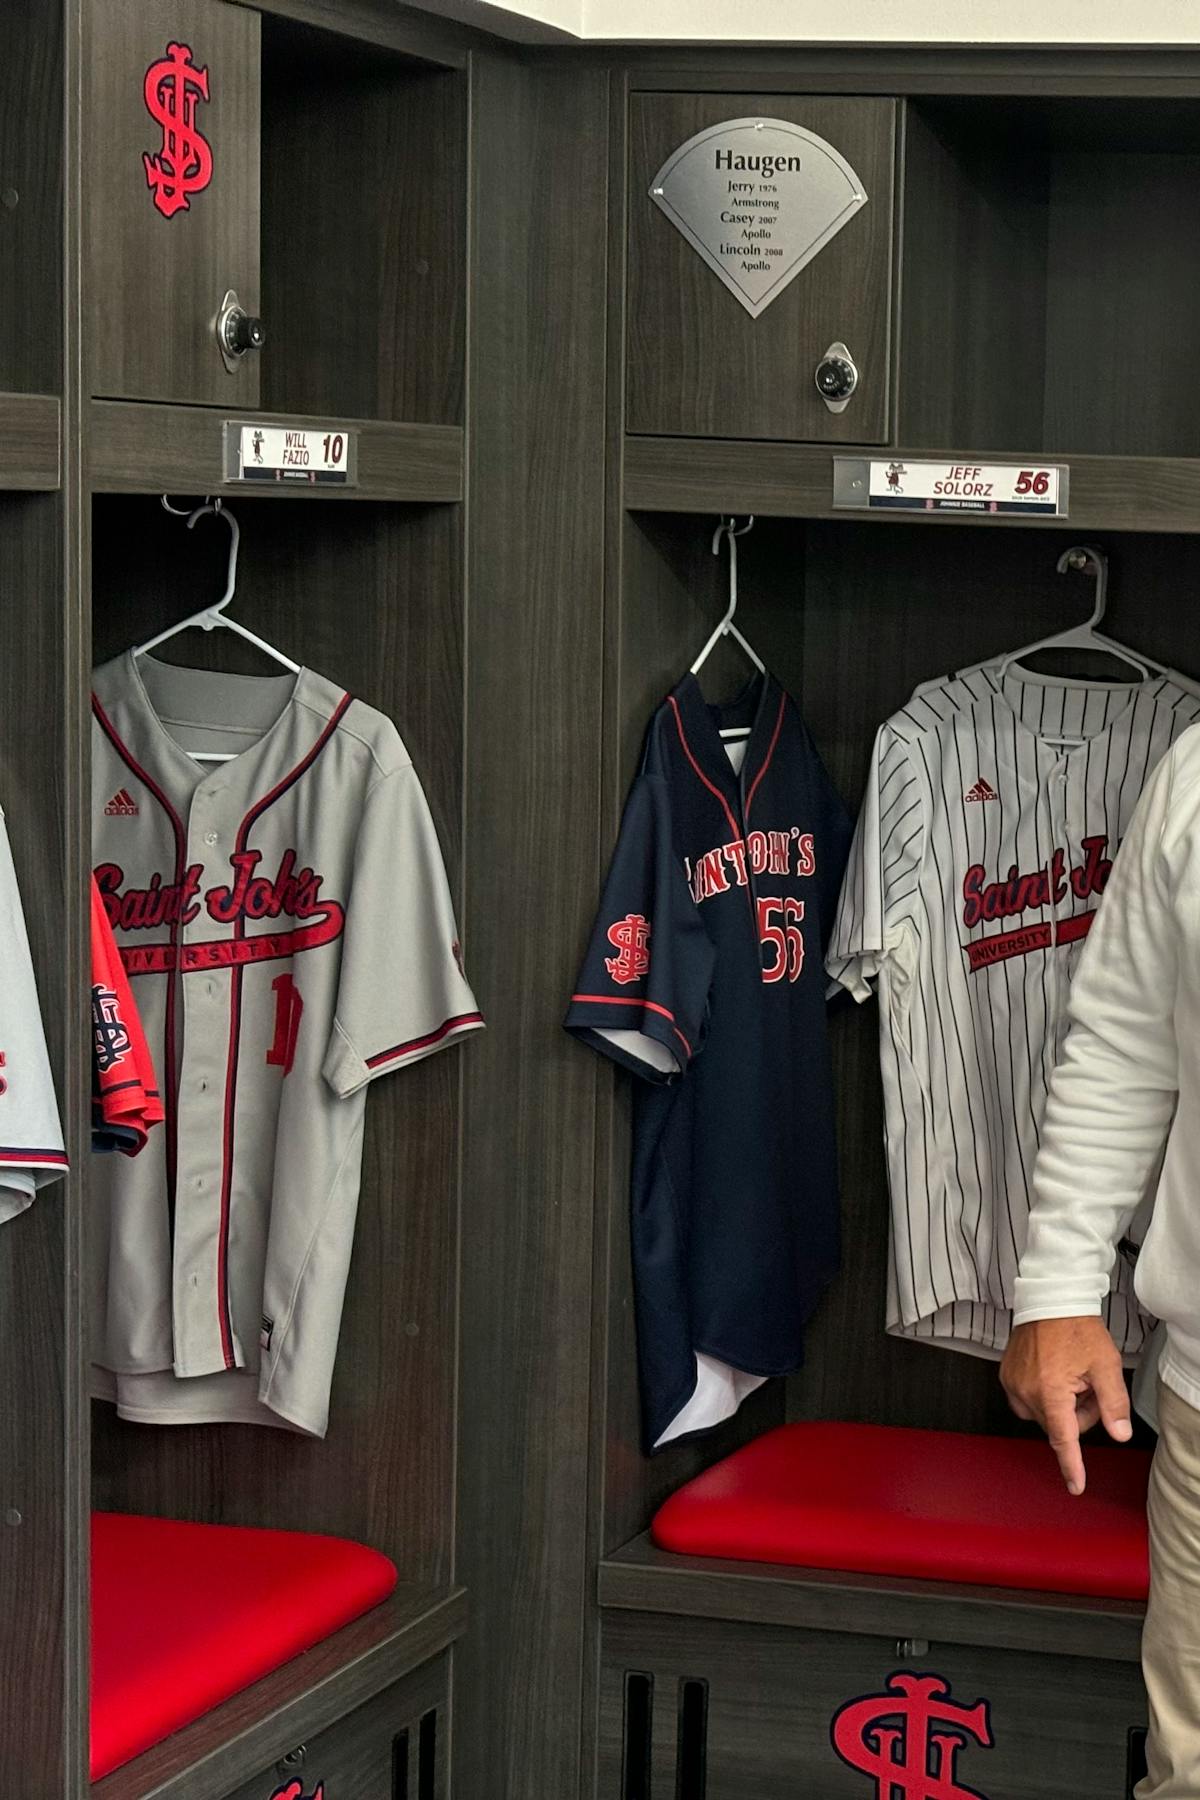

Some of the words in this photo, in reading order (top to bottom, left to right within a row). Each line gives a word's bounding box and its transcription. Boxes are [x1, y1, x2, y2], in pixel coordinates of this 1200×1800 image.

[715, 149, 801, 178] Haugen
[728, 180, 755, 193] Jerry
[759, 184, 778, 193] 1976
[731, 198, 780, 210] Armstrong
[720, 211, 755, 226] Casey
[758, 217, 777, 225] 2007
[741, 230, 771, 239] Apollo
[720, 243, 761, 256] Lincoln
[740, 262, 771, 272] Apollo
[285, 432, 307, 448] WILL
[323, 434, 344, 464] 10
[282, 450, 310, 466] FAZIO
[945, 466, 982, 481] JEFF
[933, 481, 994, 497] SOLORZ
[1014, 471, 1050, 495] 56
[104, 804, 140, 817] adidas
[204, 849, 324, 923] Joh's
[963, 847, 1068, 929] Saint
[756, 897, 805, 984] 56
[971, 928, 1049, 962] UNIVERSITY
